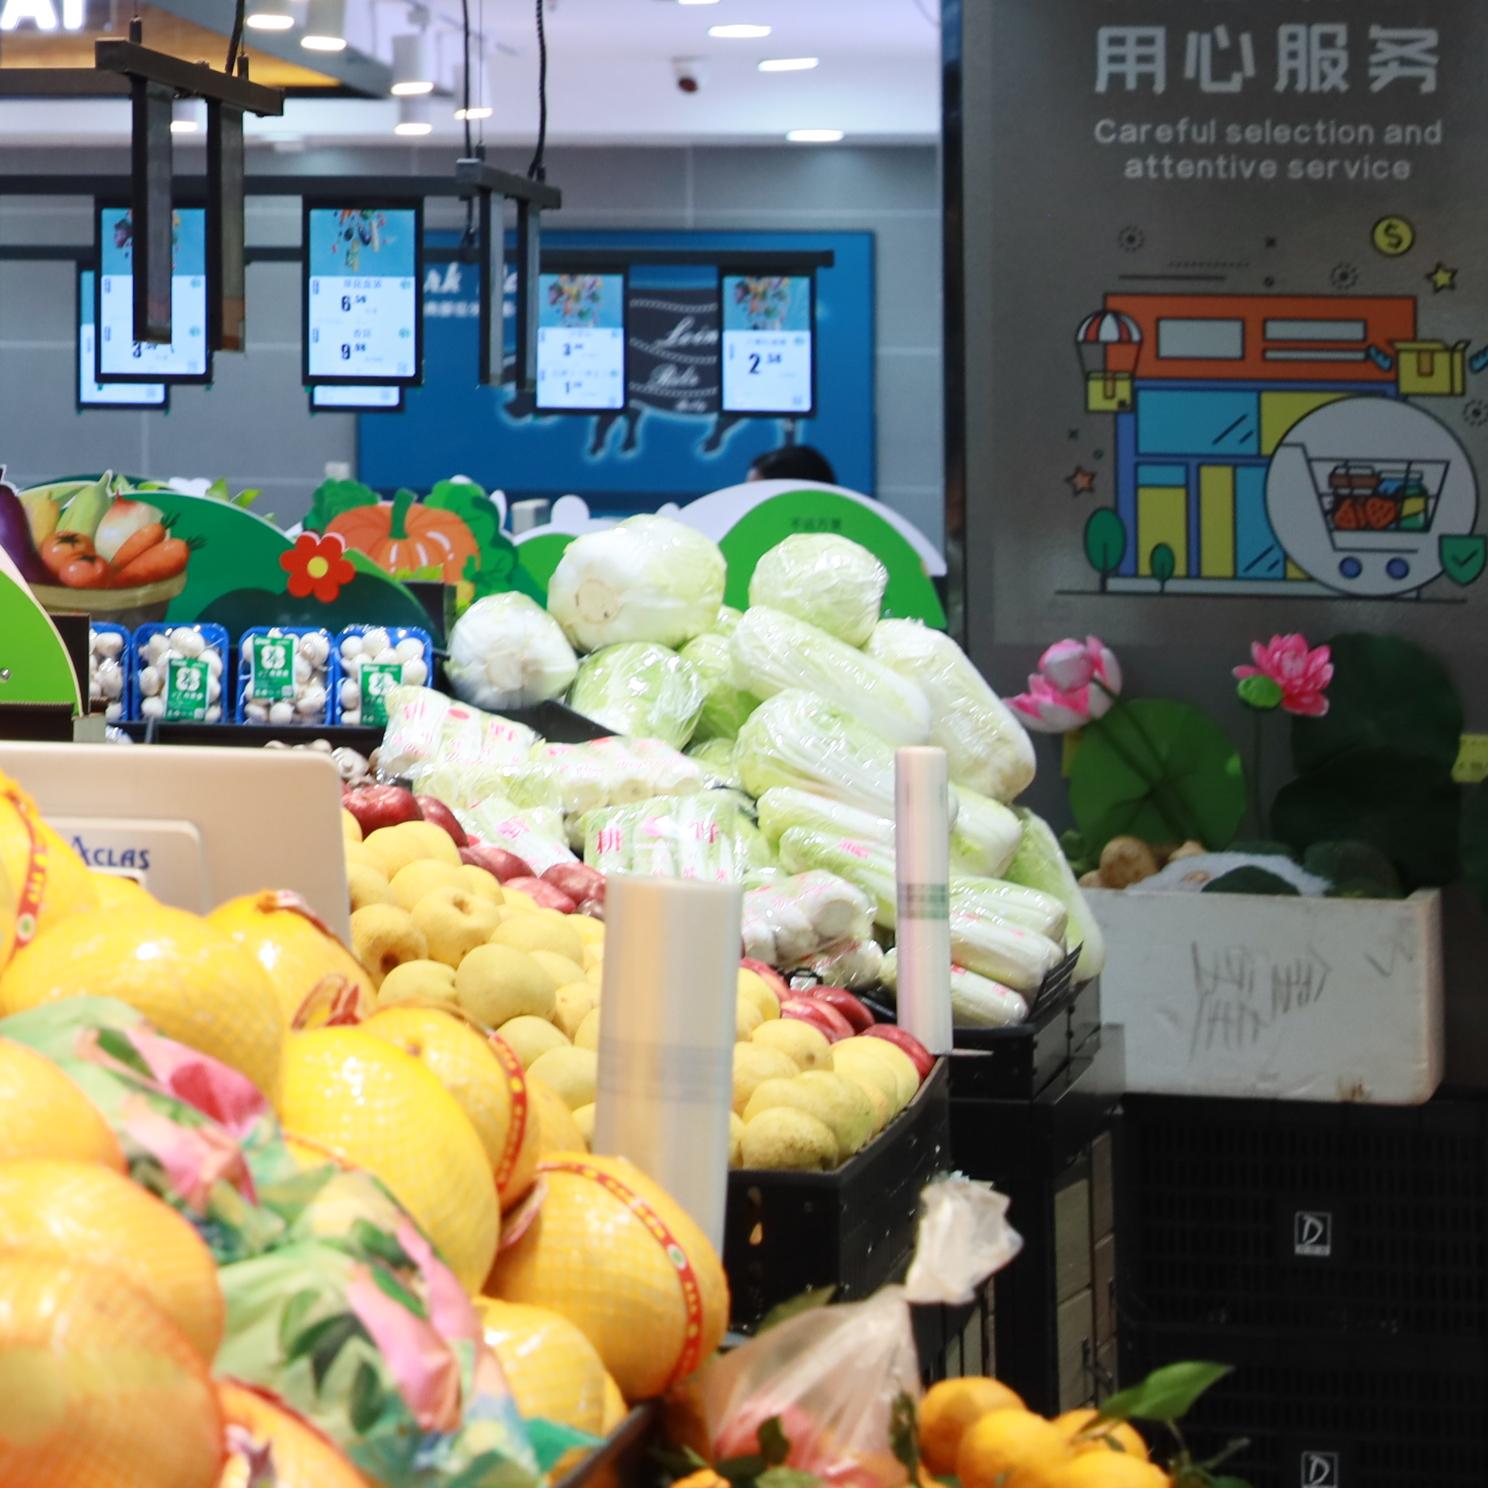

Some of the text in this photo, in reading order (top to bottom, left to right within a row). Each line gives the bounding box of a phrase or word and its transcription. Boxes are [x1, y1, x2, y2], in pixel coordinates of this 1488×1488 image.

[1093, 23, 1441, 95] 用心服务
[1093, 116, 1444, 146] Careful selection and
[1123, 153, 1412, 181] attentive service
